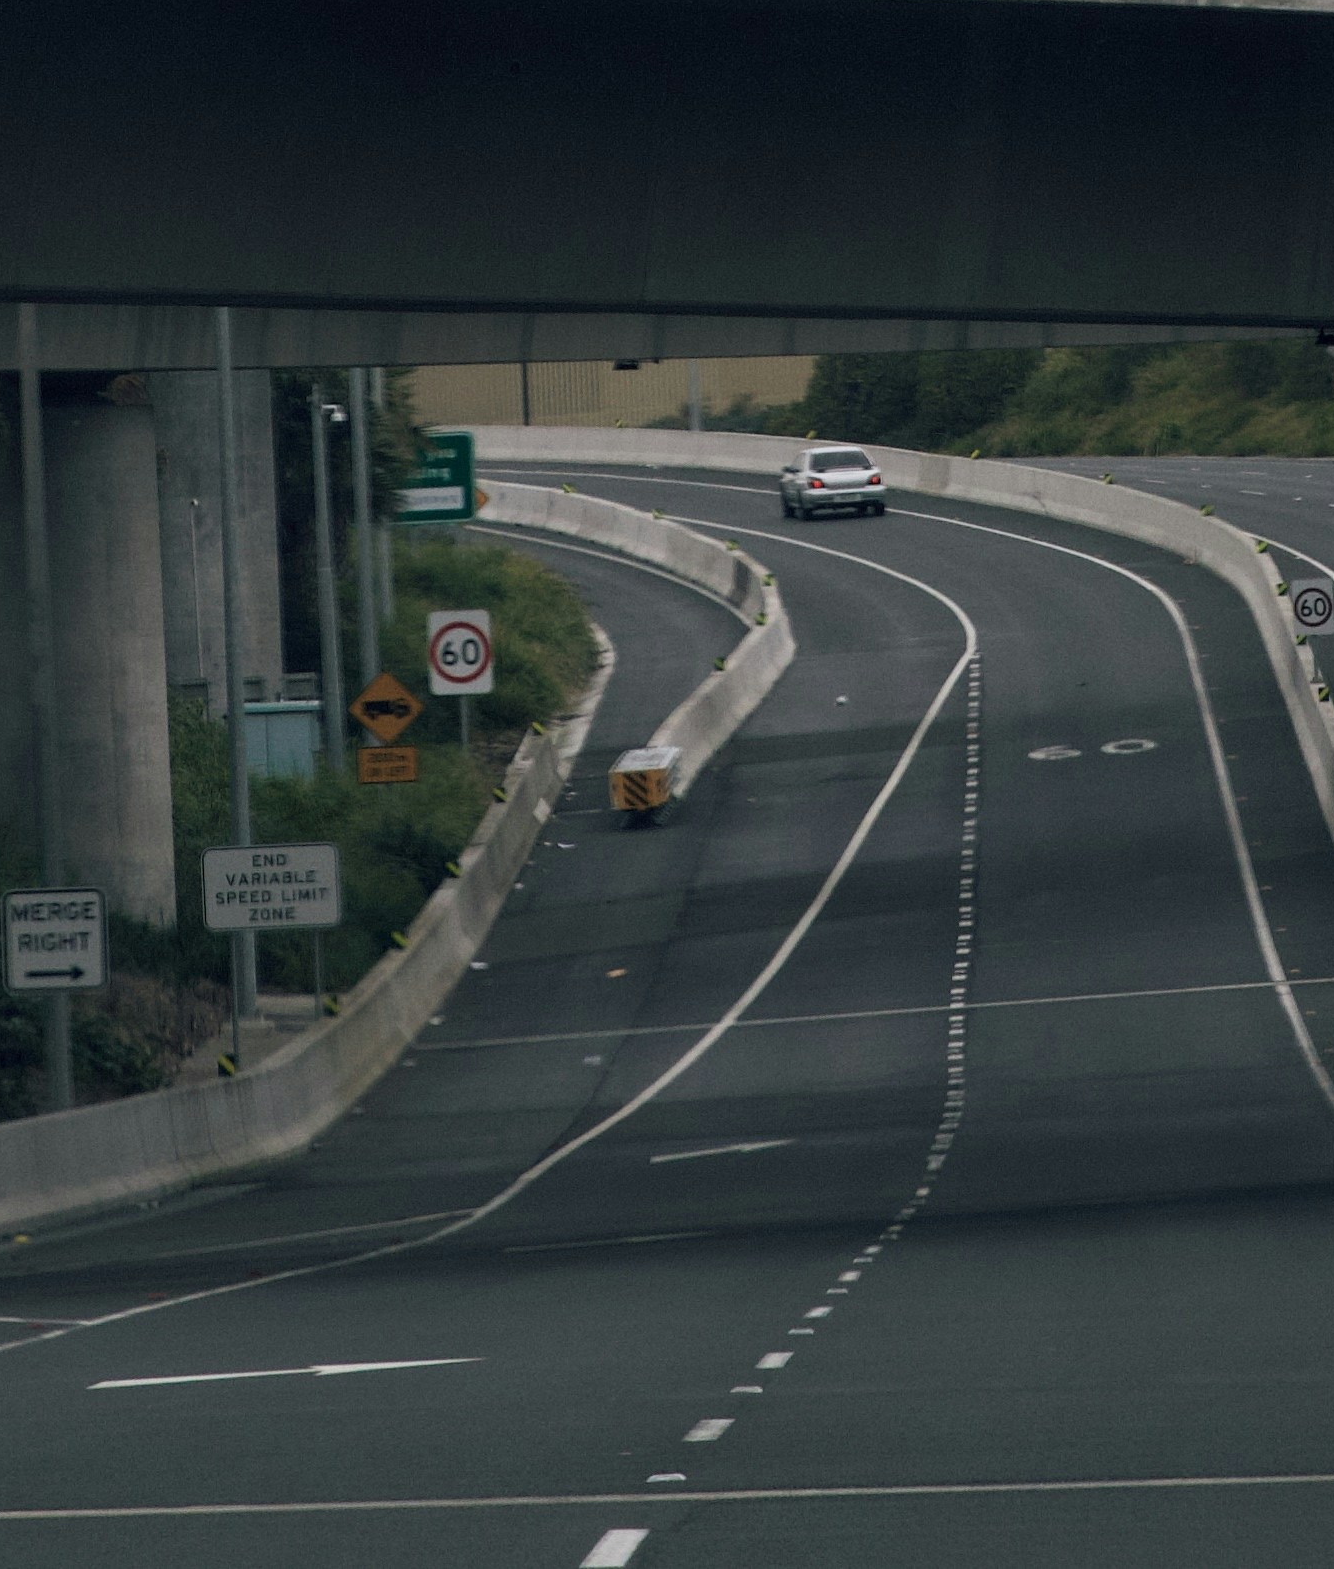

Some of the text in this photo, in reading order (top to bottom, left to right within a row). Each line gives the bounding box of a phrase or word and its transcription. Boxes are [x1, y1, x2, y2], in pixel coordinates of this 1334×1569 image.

[1300, 597, 1327, 617] 60
[442, 638, 480, 666] 60
[1028, 738, 1160, 761] 60
[252, 853, 288, 868] END
[225, 870, 317, 887] VARIABLE
[215, 887, 329, 905] SPEED LIMIT
[10, 901, 98, 923] MERGE
[248, 906, 297, 922] ZONE
[17, 931, 91, 954] RIGHT
